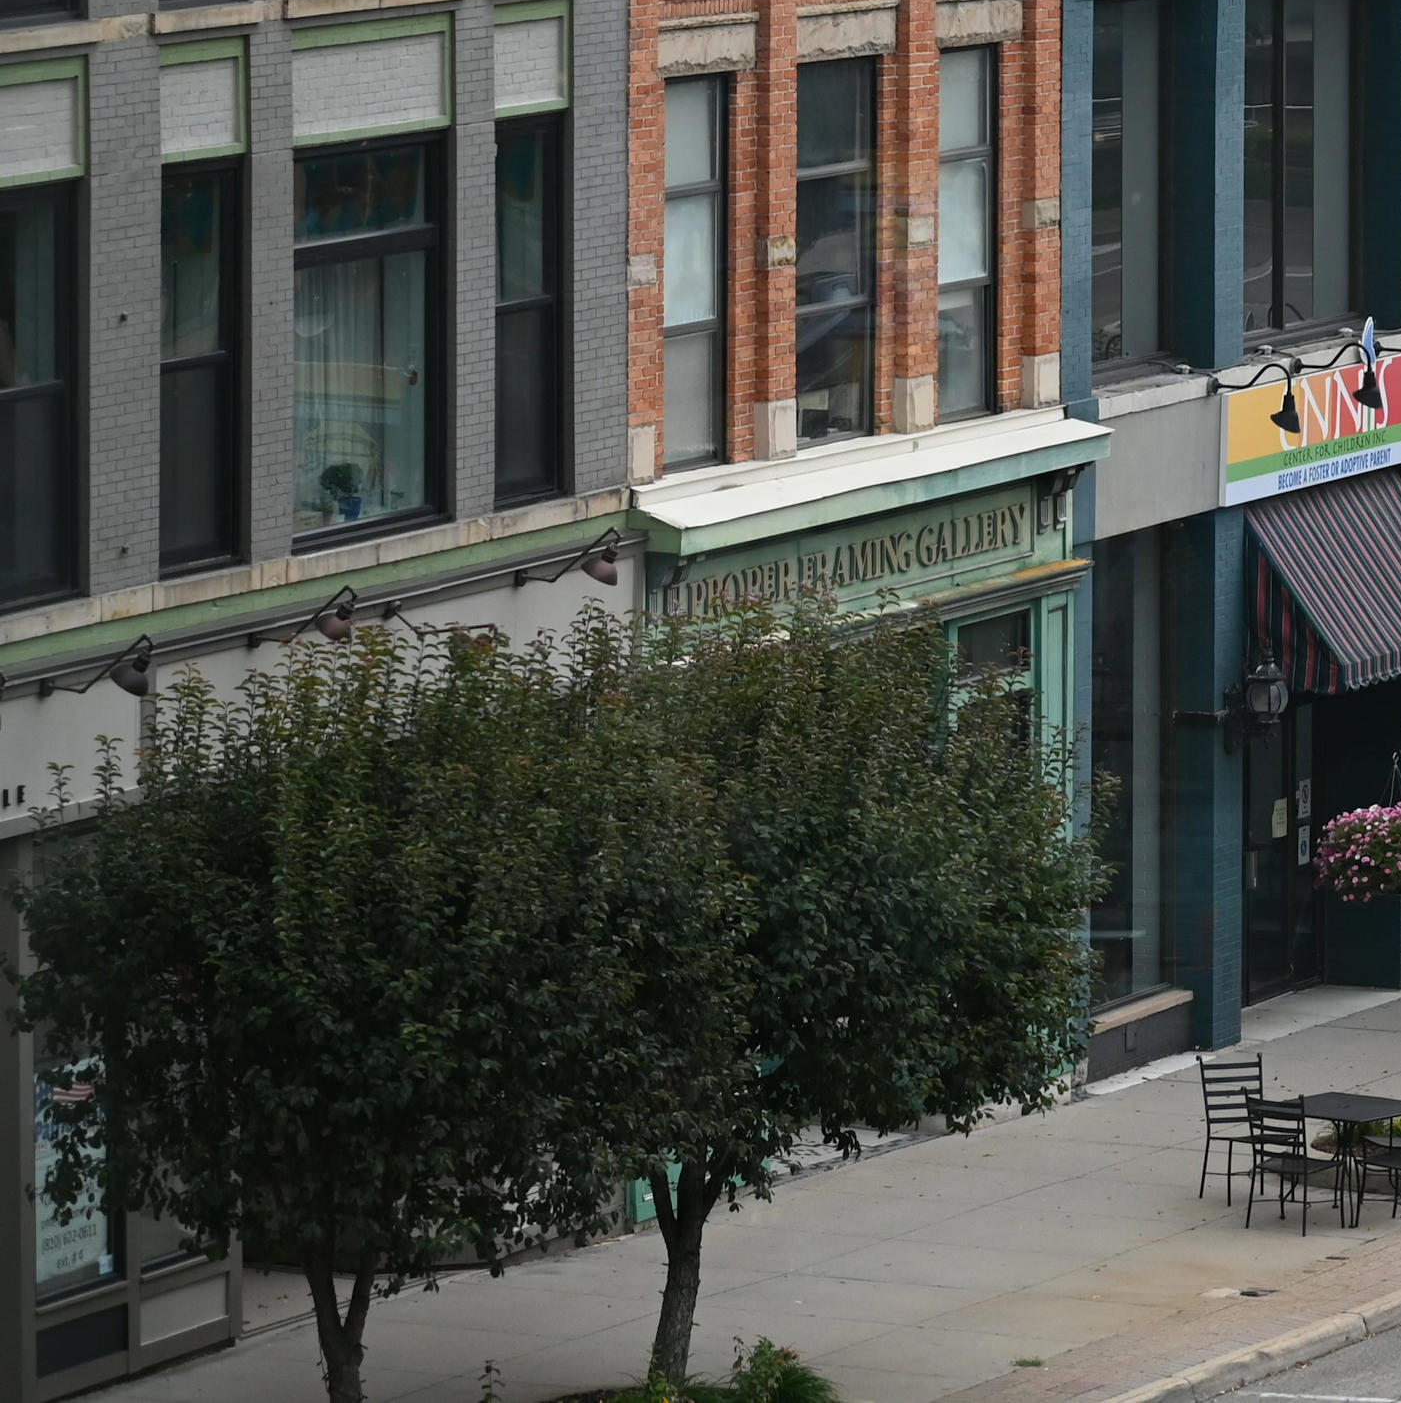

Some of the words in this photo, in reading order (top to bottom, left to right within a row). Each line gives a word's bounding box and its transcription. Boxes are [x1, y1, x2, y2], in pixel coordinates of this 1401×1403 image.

[1278, 470, 1303, 490] BECOME
[1303, 468, 1308, 483] A
[1309, 462, 1330, 482] FOSTER
[1331, 461, 1340, 477] OR
[1341, 454, 1369, 473] ADOPTIVE
[1370, 448, 1391, 467] PARENT
[1284, 448, 1313, 467] CENTER
[1315, 443, 1330, 460] FOR
[1332, 434, 1371, 455] CHILDREN
[1372, 429, 1387, 446] INC
[689, 557, 798, 619] PROPER
[800, 530, 913, 589] FRAMING
[917, 503, 1030, 566] GALLERY
